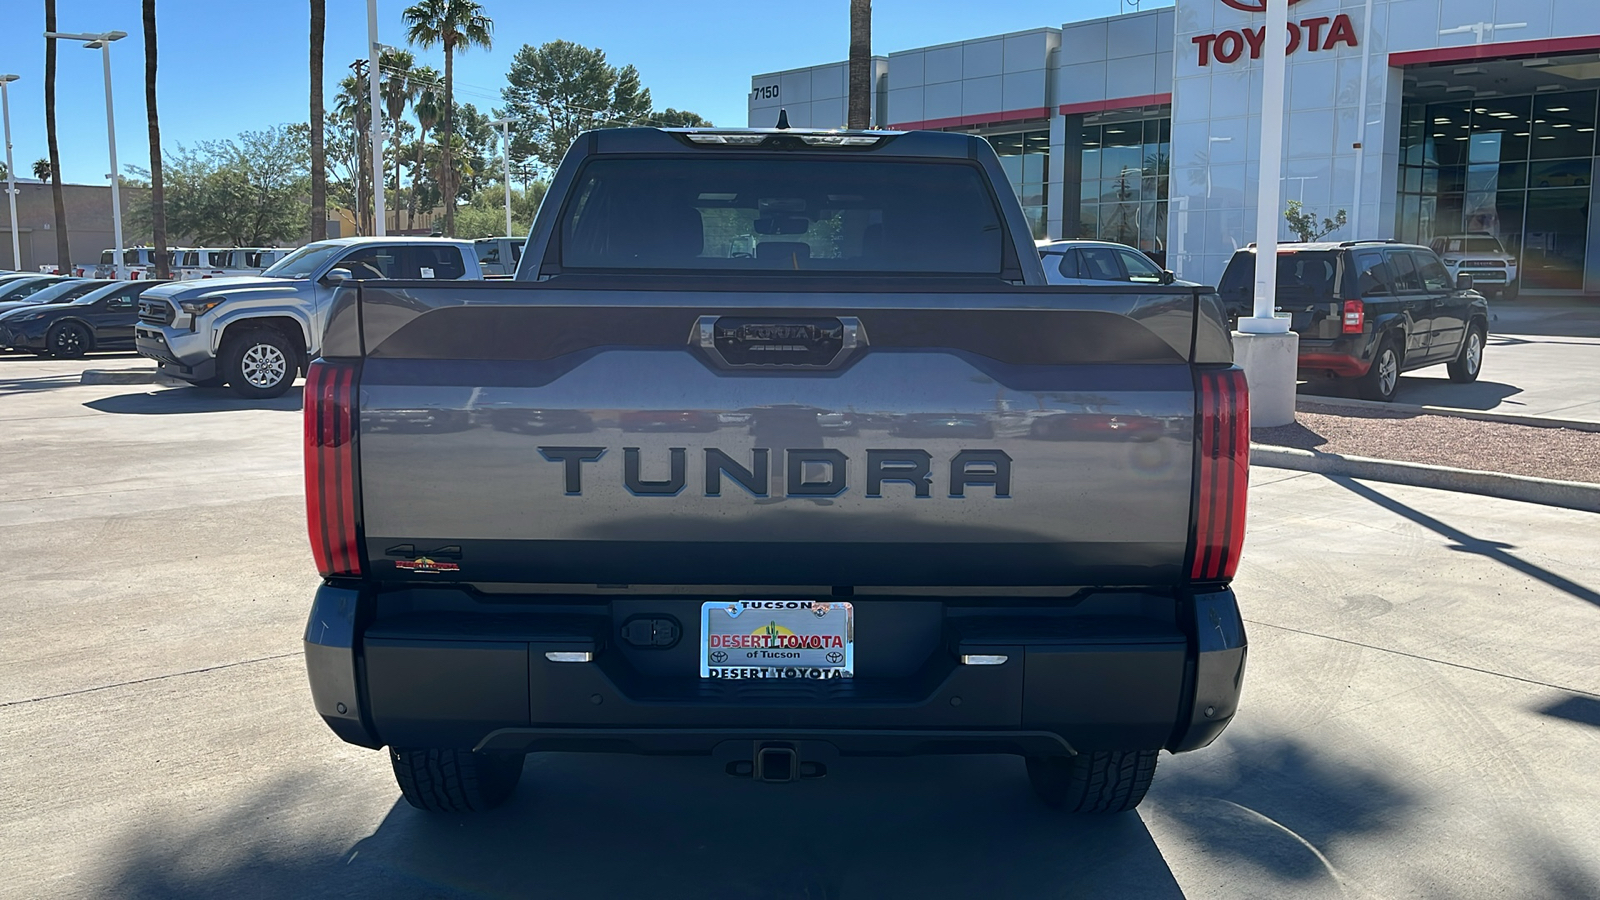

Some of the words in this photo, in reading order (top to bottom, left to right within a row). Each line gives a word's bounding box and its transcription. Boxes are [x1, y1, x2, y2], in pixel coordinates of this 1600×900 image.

[753, 85, 779, 100] 7150
[749, 326, 809, 339] OYOTA
[537, 446, 1014, 499] TUNDRA
[741, 601, 813, 609] TUCSON
[710, 634, 772, 648] DESERT
[777, 634, 844, 648] TOYOTA
[746, 650, 758, 659] of
[760, 650, 801, 659] Tucson
[709, 668, 770, 679] DESERT
[775, 668, 842, 679] TOYOTA
